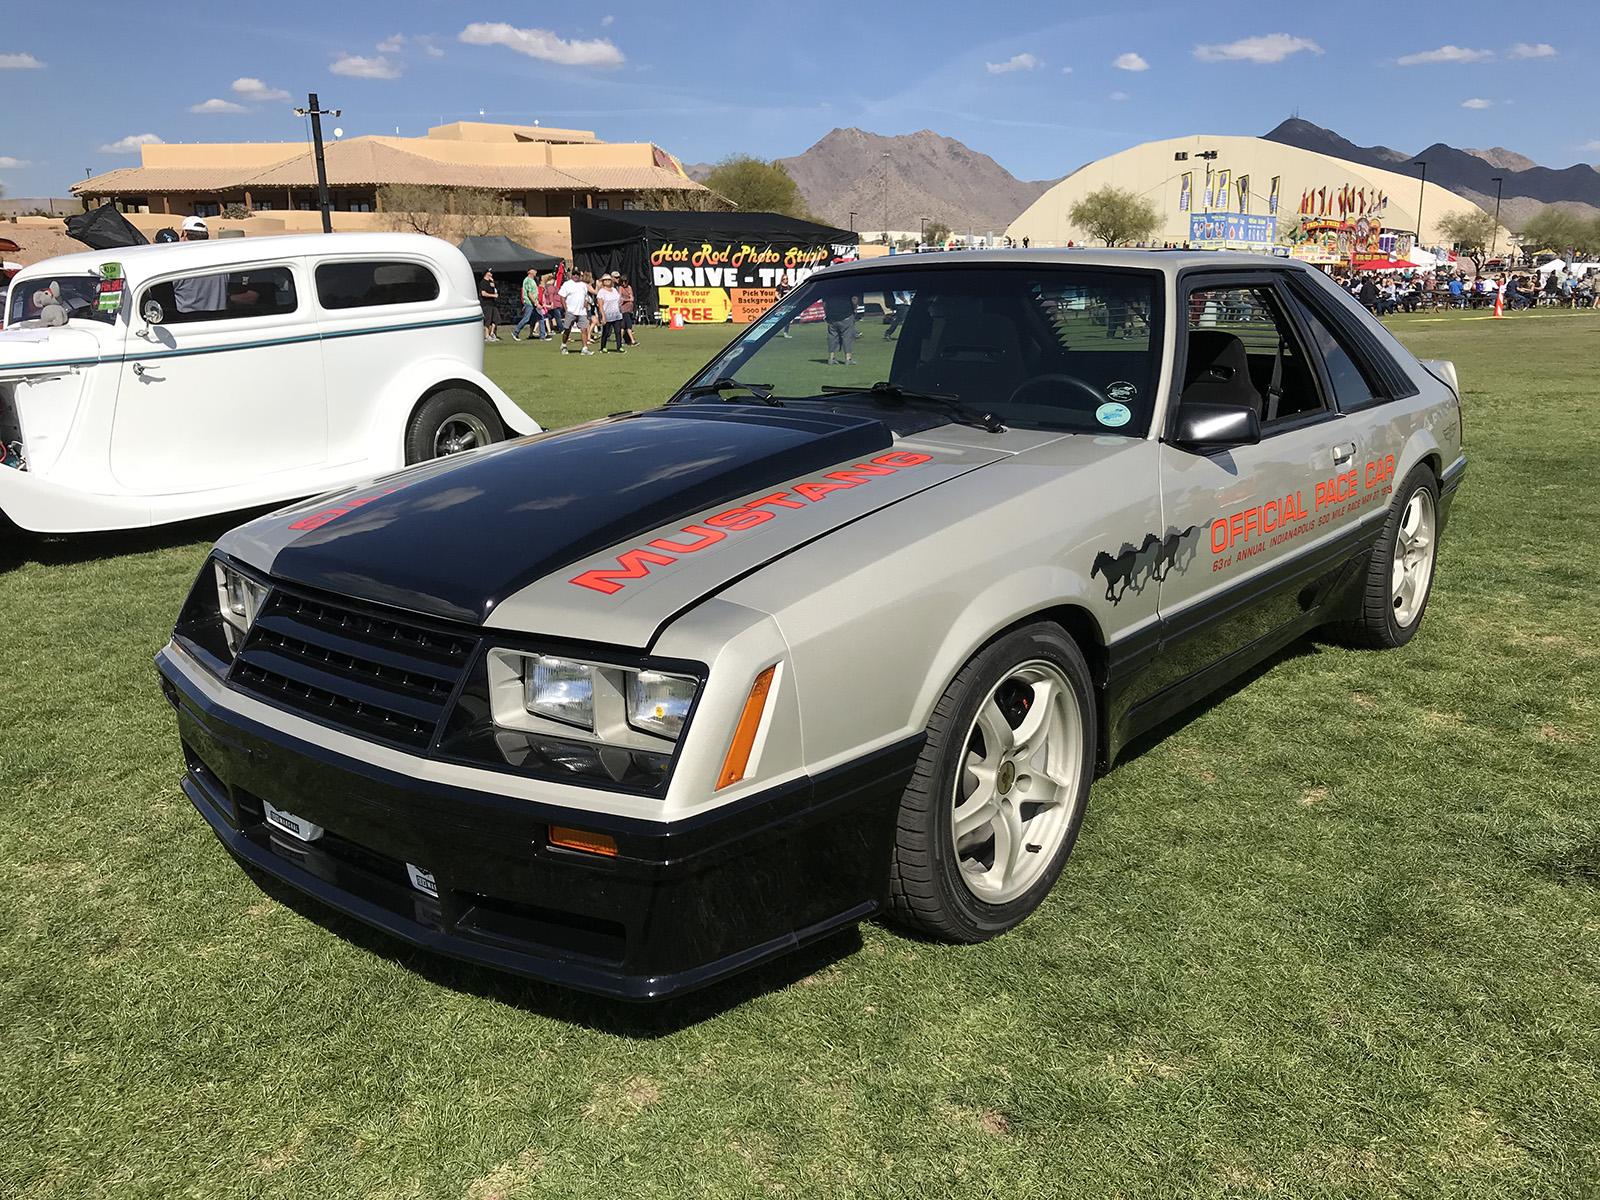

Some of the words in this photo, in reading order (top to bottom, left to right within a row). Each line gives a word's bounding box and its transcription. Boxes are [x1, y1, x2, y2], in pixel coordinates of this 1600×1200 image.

[651, 243, 689, 266] Hot
[692, 243, 731, 267] Rod
[731, 245, 780, 268] Photo
[784, 246, 828, 268] Studio
[653, 266, 738, 287] DRIVE
[669, 307, 712, 321] FREE
[568, 451, 933, 595] MUSTANG
[1210, 490, 1308, 554] OFFICIAL
[1315, 468, 1358, 513] PACE
[1364, 454, 1395, 490] CAR
[1212, 555, 1232, 572] 63rd
[1236, 542, 1266, 562] ANNUAL
[1269, 520, 1315, 547] INDIANAPOLIS
[1318, 512, 1330, 527] 500
[1332, 506, 1345, 520] MILE
[1347, 499, 1361, 512] RACE
